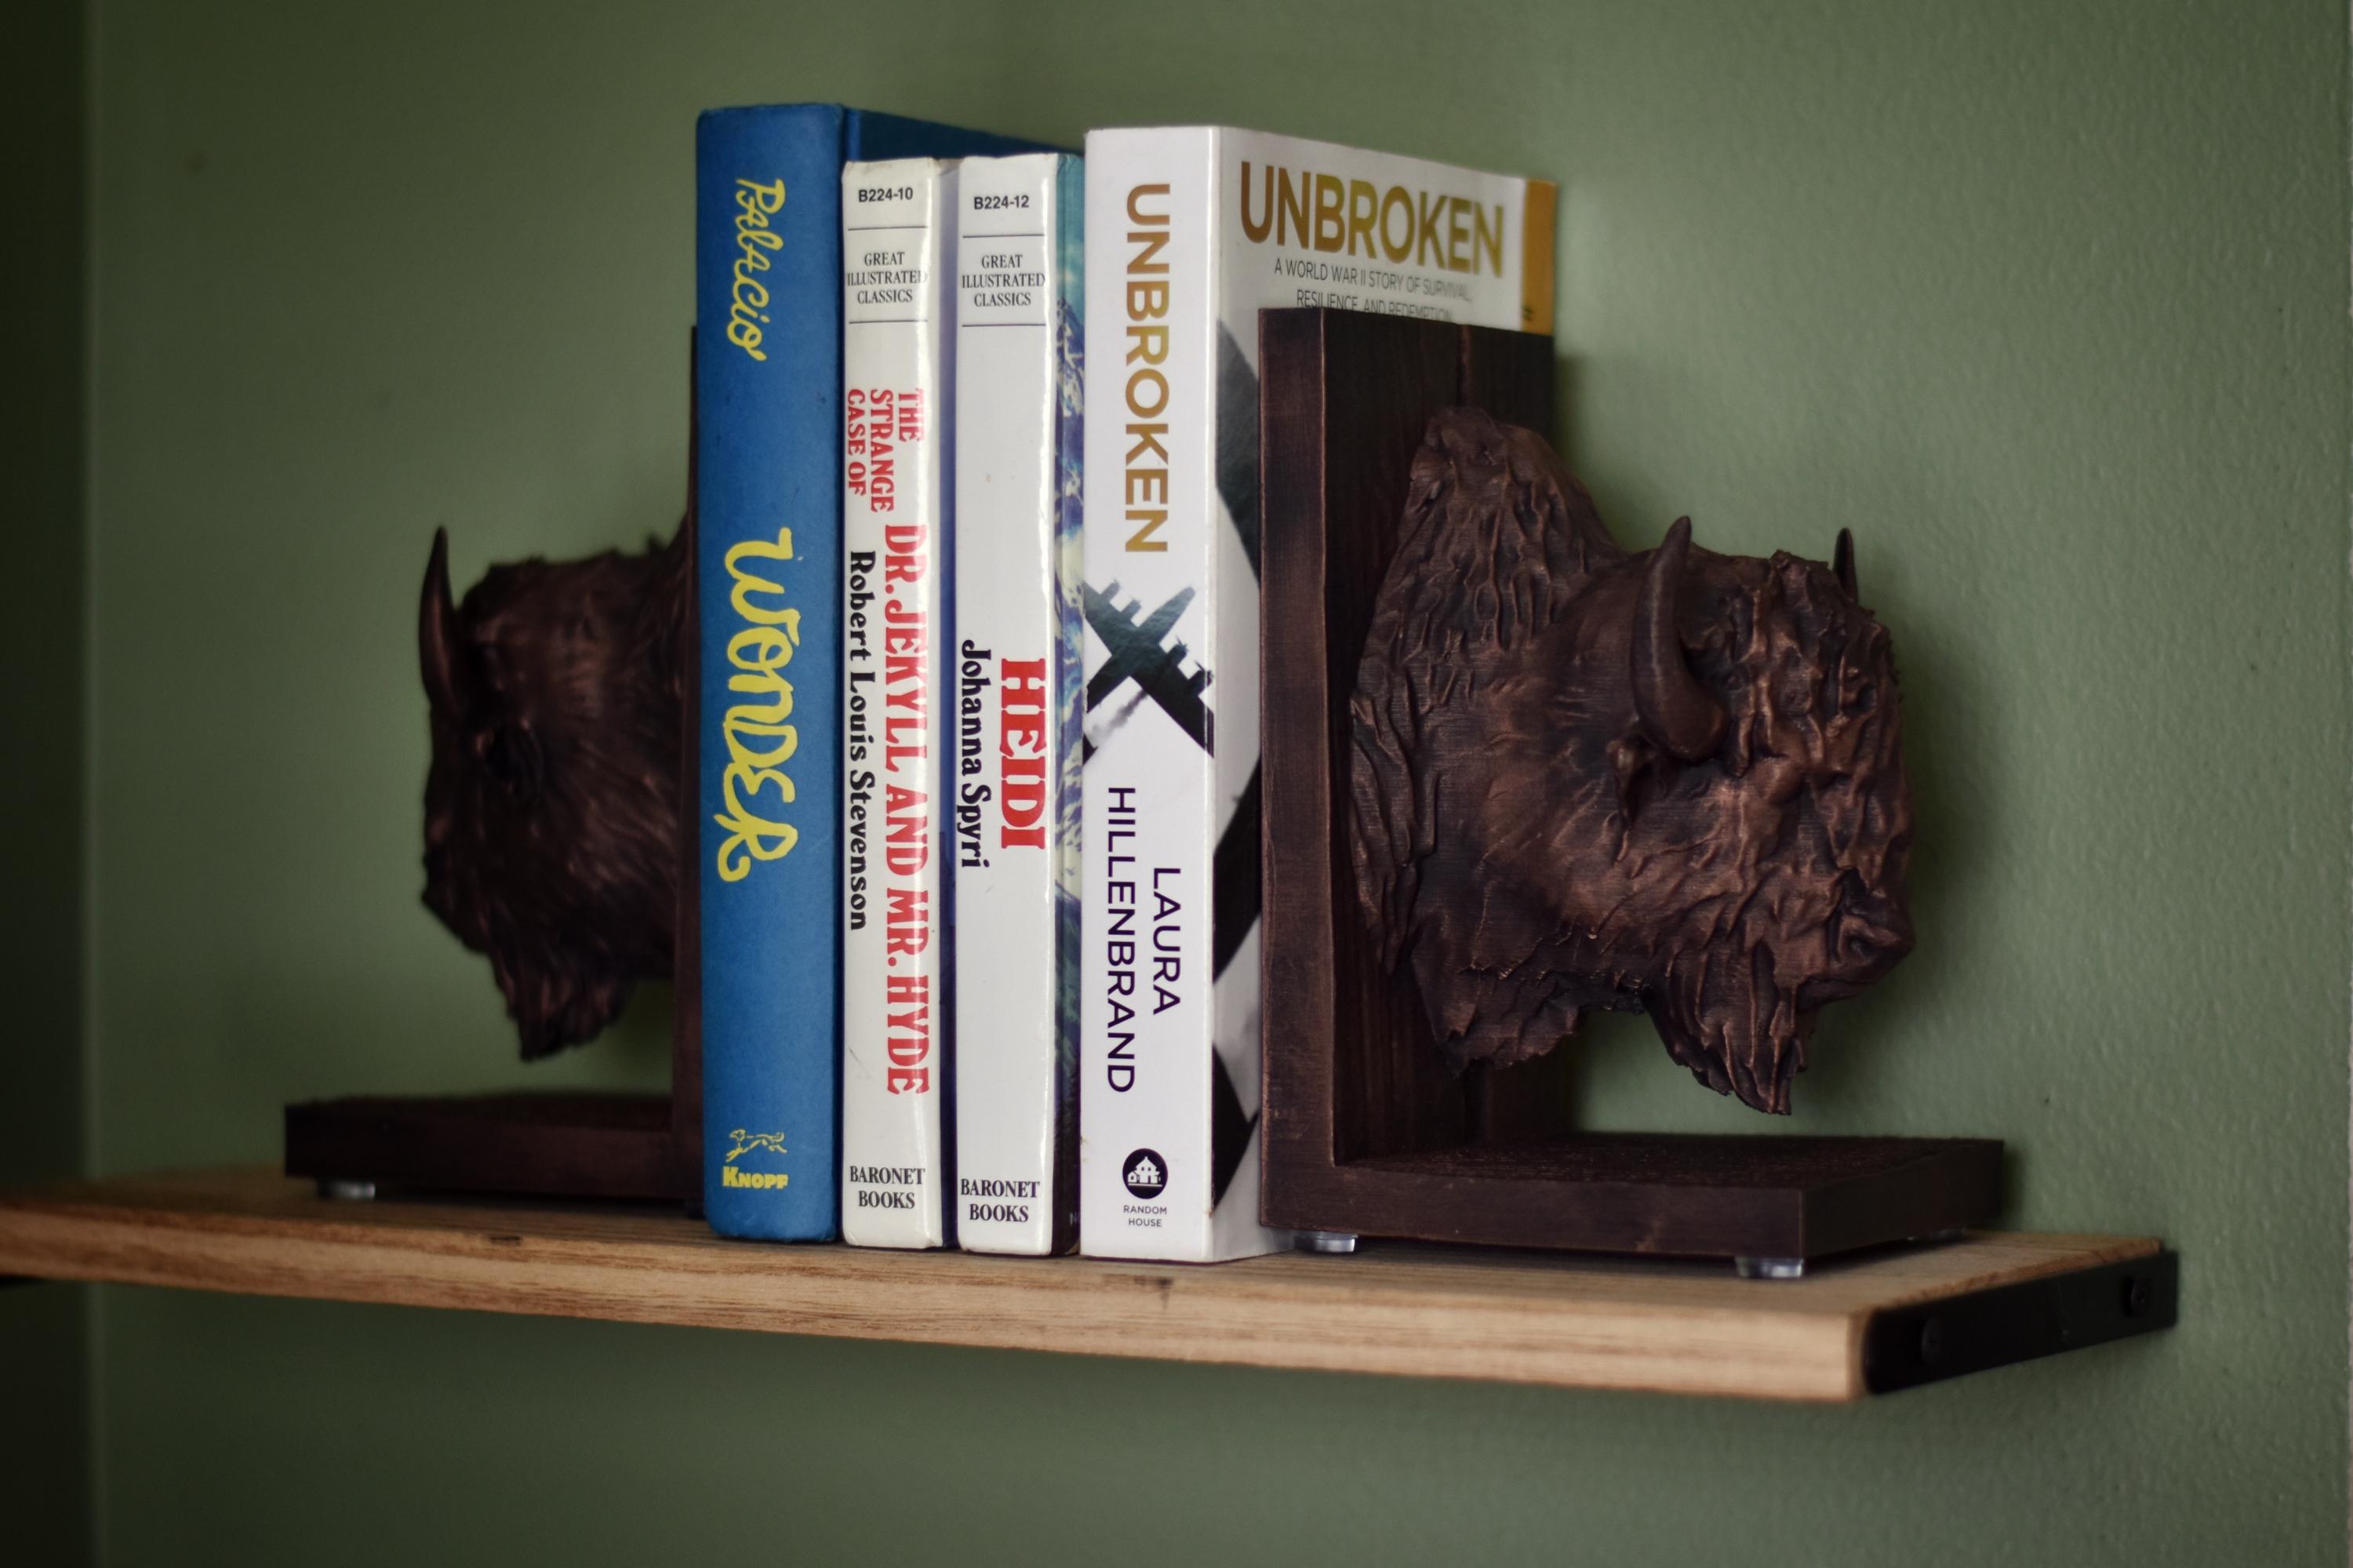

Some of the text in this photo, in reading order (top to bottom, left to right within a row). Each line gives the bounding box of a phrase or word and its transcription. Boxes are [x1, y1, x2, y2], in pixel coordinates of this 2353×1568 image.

[858, 187, 914, 202] B224-10
[973, 195, 1030, 210] B224-12
[1240, 162, 1504, 278] UNBROKEN
[864, 252, 905, 266] GREAT
[981, 255, 1023, 268] GREAT
[847, 271, 928, 286] ILLUSTRATED
[962, 273, 1046, 288] ILLUSTRATED
[1275, 257, 1282, 275] A
[1286, 259, 1328, 281] WORLD
[1331, 265, 1358, 285] WAR
[1360, 269, 1366, 286] II
[1369, 271, 1404, 291] STORY
[1406, 276, 1421, 293] OF
[857, 289, 913, 304] CLASSICS
[974, 293, 1031, 307] CLASSICS
[1363, 298, 1384, 314] AND
[1125, 184, 1170, 552] UNBROKEN
[898, 388, 924, 442] THE
[847, 389, 867, 496] CASE OF
[870, 389, 894, 512] STRANGE
[849, 551, 876, 930] Robert Louis Stevenson
[957, 639, 991, 868] Johanna Spyri
[999, 658, 1047, 849] HEIDI
[886, 784, 929, 875] AND
[886, 888, 929, 966] MR.
[1107, 788, 1136, 1093] HILLENBRAND
[1153, 868, 1181, 1016] LAURA
[887, 975, 929, 1095] HYDE
[850, 1166, 926, 1185] BARONET
[960, 1178, 1040, 1198] BARONET
[858, 1191, 915, 1209] BOOKS
[969, 1203, 1028, 1223] BOOKS
[1123, 1206, 1167, 1215] RANDOM
[1129, 1219, 1162, 1228] HOUSE
